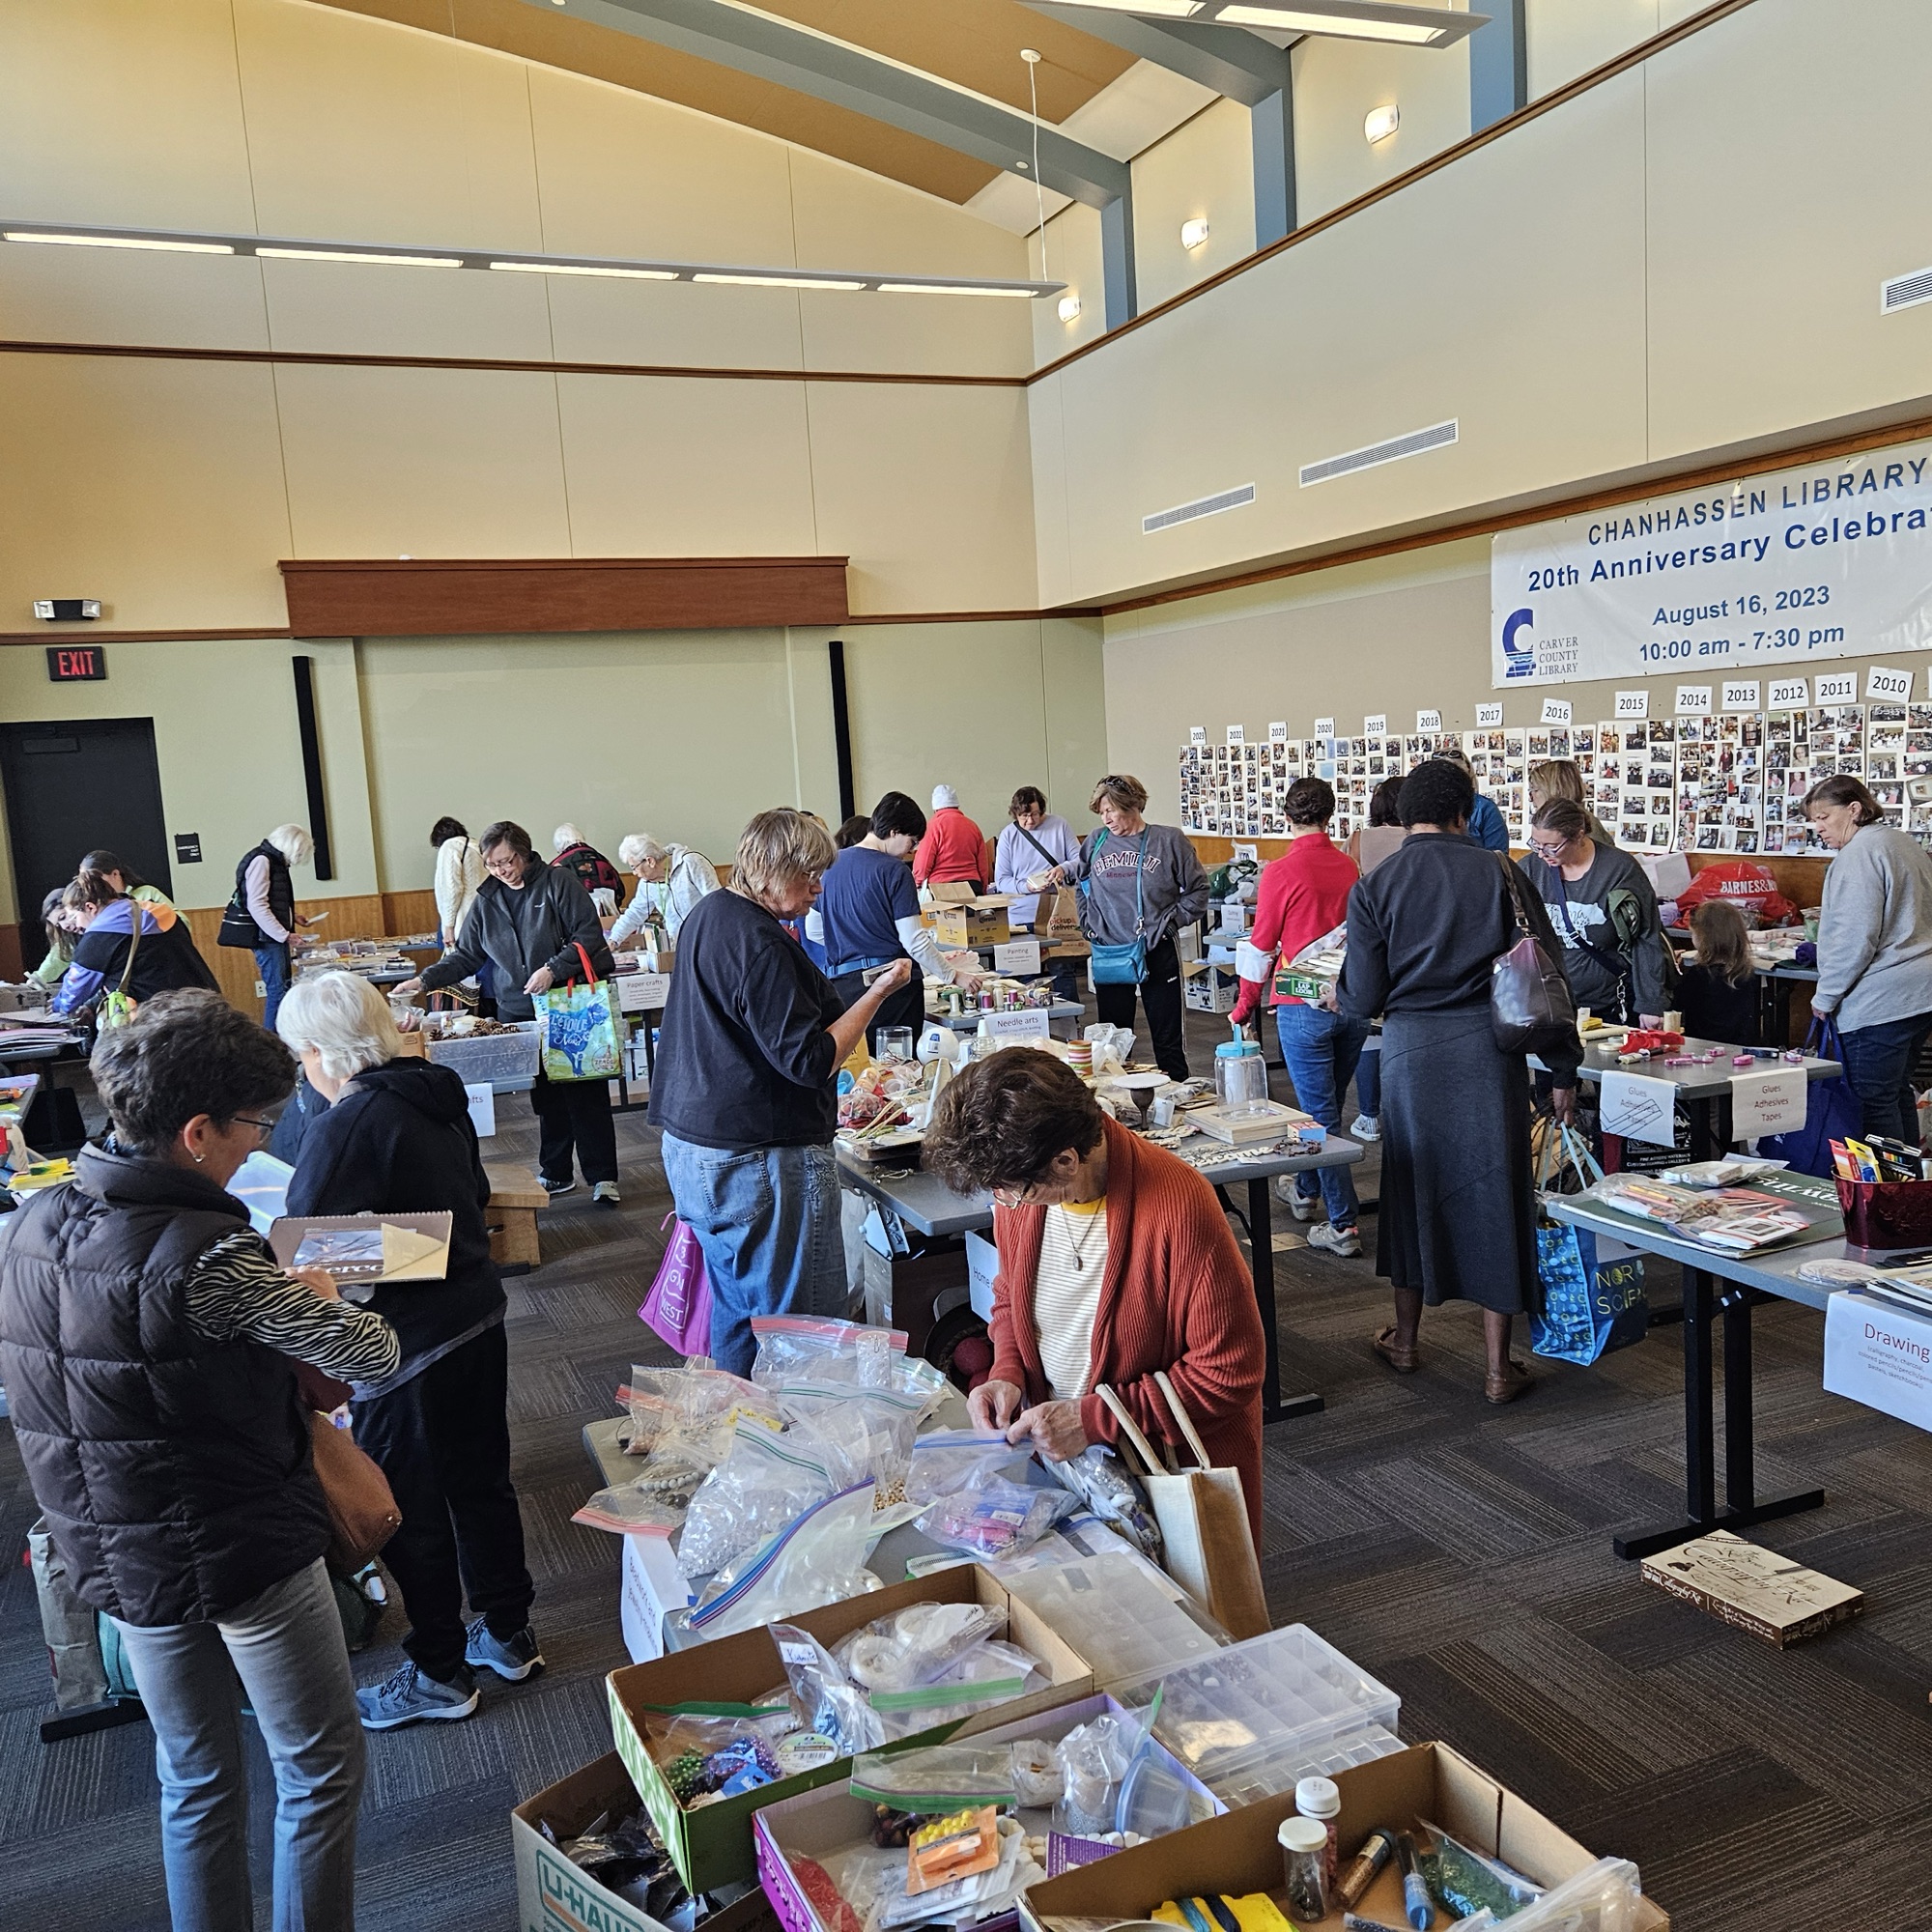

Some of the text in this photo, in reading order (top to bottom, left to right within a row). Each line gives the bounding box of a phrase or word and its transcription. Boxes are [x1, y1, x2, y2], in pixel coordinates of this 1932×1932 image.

[1588, 457, 1927, 546] CHANHASSEN LIBRARY
[1528, 506, 1932, 592] 20th Anniversary Celebra
[1652, 585, 1830, 626] August 16, 2023
[1539, 637, 1578, 650] CARVER
[1639, 639, 1691, 661] 10:00
[1698, 639, 1730, 655] am
[1752, 628, 1800, 650] 7:30
[1807, 627, 1844, 649] pm
[58, 651, 94, 675] EXIT
[1539, 649, 1578, 664] COUNTY
[1539, 662, 1578, 676] LIBRARY
[1820, 681, 1853, 696] 2011
[1872, 675, 1907, 694] 2010
[1680, 694, 1707, 706] 2014
[1727, 689, 1755, 702] 2013
[1774, 686, 1804, 701] 2012
[1619, 698, 1644, 711] 2015
[1480, 709, 1500, 722] 2017
[1545, 706, 1570, 720] 2016
[1317, 724, 1333, 734] 2020
[1367, 721, 1384, 732] 2019
[1420, 717, 1439, 728] 2018
[1192, 731, 1206, 741] 2023
[1229, 730, 1242, 740] 2022
[1271, 727, 1285, 738] 2021
[1049, 917, 1071, 925] pickup
[1295, 986, 1314, 995] LOOM
[1297, 980, 1311, 989] LAP
[997, 1017, 1023, 1028] Needle
[1629, 1087, 1647, 1097] Glues
[1762, 1085, 1781, 1094] Glues
[1754, 1097, 1789, 1109] Adhesives
[1761, 1112, 1782, 1122] Tapes
[973, 1265, 991, 1289] Home
[1864, 1322, 1930, 1363] Drawing
